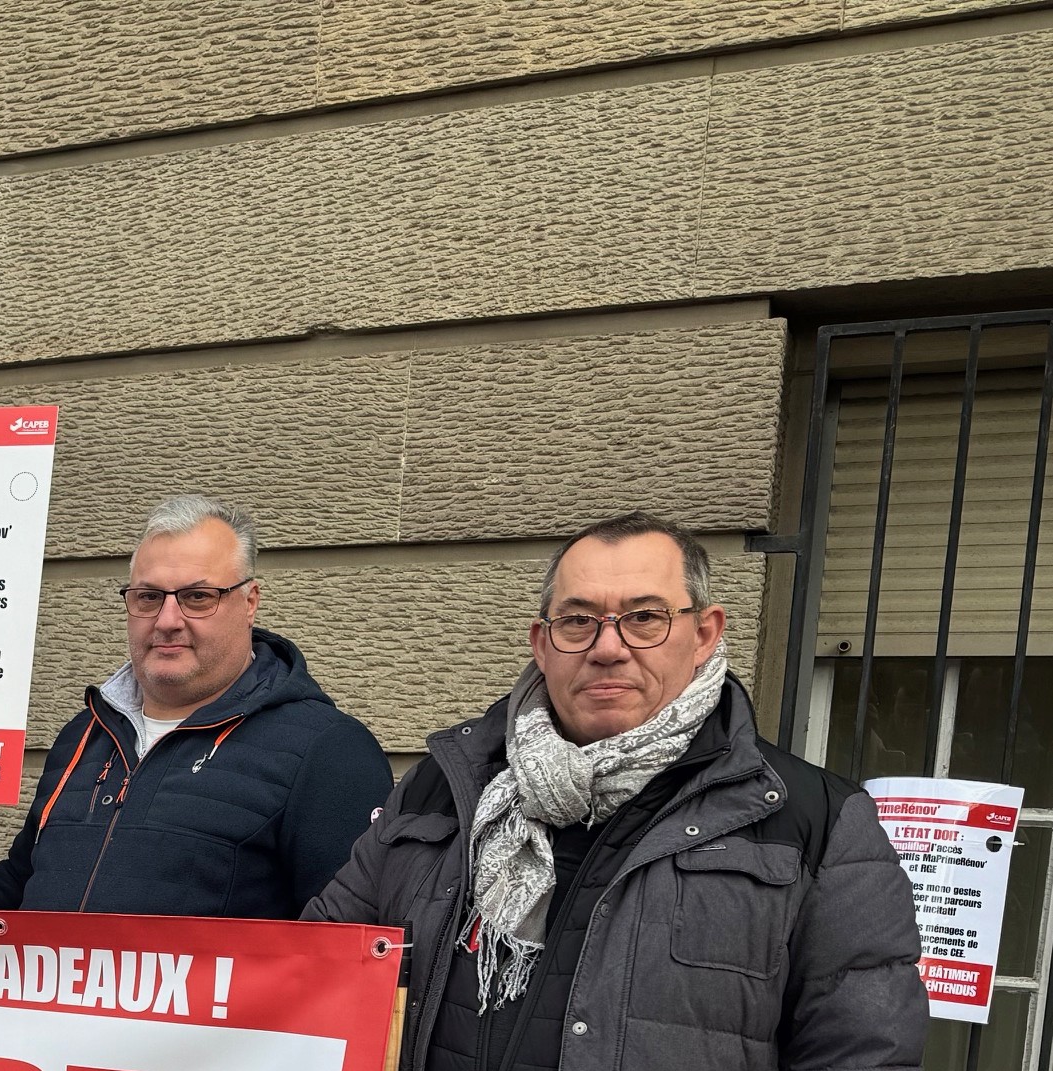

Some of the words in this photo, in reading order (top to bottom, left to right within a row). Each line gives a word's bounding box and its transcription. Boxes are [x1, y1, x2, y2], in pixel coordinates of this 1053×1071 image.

[23, 420, 49, 429] CAPEB
[876, 801, 941, 816] rimeRénov'
[895, 825, 931, 839] L'ÉTAT
[933, 829, 960, 841] DOIT
[891, 841, 929, 852] implifier
[931, 843, 963, 855] l'accès
[898, 852, 920, 861] sitifs
[909, 863, 918, 872] et
[920, 864, 937, 873] RGE
[913, 882, 924, 891] es
[953, 887, 981, 897] gestes
[931, 895, 943, 903] un
[944, 896, 982, 909] parcours
[923, 906, 957, 916] incitatif
[925, 924, 965, 936] ménages
[966, 929, 977, 938] en
[919, 934, 965, 947] ancements
[967, 939, 979, 949] de
[932, 946, 948, 956] des
[928, 965, 980, 983] BÂTIMENT
[213, 957, 234, 1020] !
[926, 980, 977, 997] ENTENDUS
